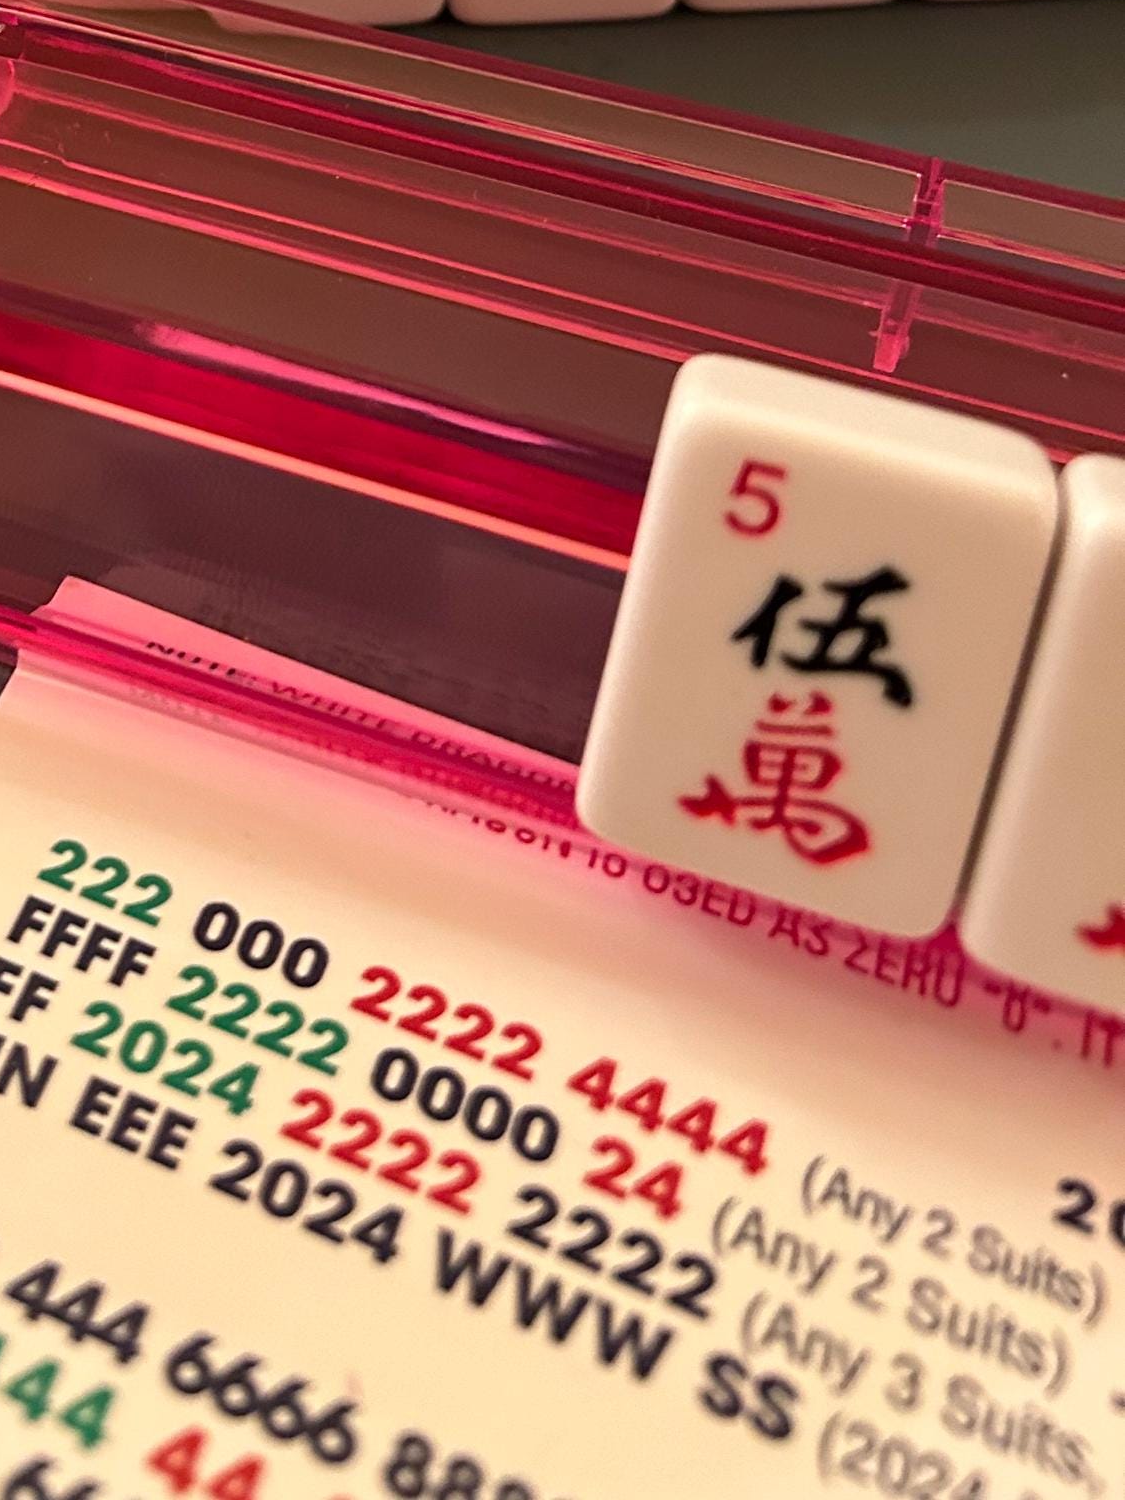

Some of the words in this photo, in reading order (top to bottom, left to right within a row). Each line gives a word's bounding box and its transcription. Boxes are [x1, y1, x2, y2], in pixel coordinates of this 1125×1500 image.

[723, 460, 789, 538] 5
[6, 895, 157, 988] FFFF
[166, 964, 349, 1077] 2222
[584, 1136, 685, 1220] 24
[711, 1197, 837, 1294] (Any
[851, 1255, 889, 1314] 2
[905, 1276, 1071, 1399] Suits)
[37, 839, 172, 926] 222
[351, 966, 544, 1081] 2222
[569, 1056, 770, 1176] 4444
[802, 1154, 911, 1244] (Any
[923, 1208, 956, 1257] 2
[968, 1224, 1109, 1328] Suits)
[69, 1078, 197, 1170] EEE
[208, 1140, 406, 1265] 2024
[434, 1226, 672, 1382] WWW
[698, 1353, 800, 1441] SS
[70, 1000, 263, 1116] 2024
[280, 1087, 480, 1216] 2222
[509, 1184, 718, 1320] 2222
[740, 1292, 869, 1395] (Any
[883, 1351, 923, 1415] 3
[3, 1259, 150, 1364] 444
[164, 1331, 359, 1465] 6666
[146, 1425, 267, 1500] 44
